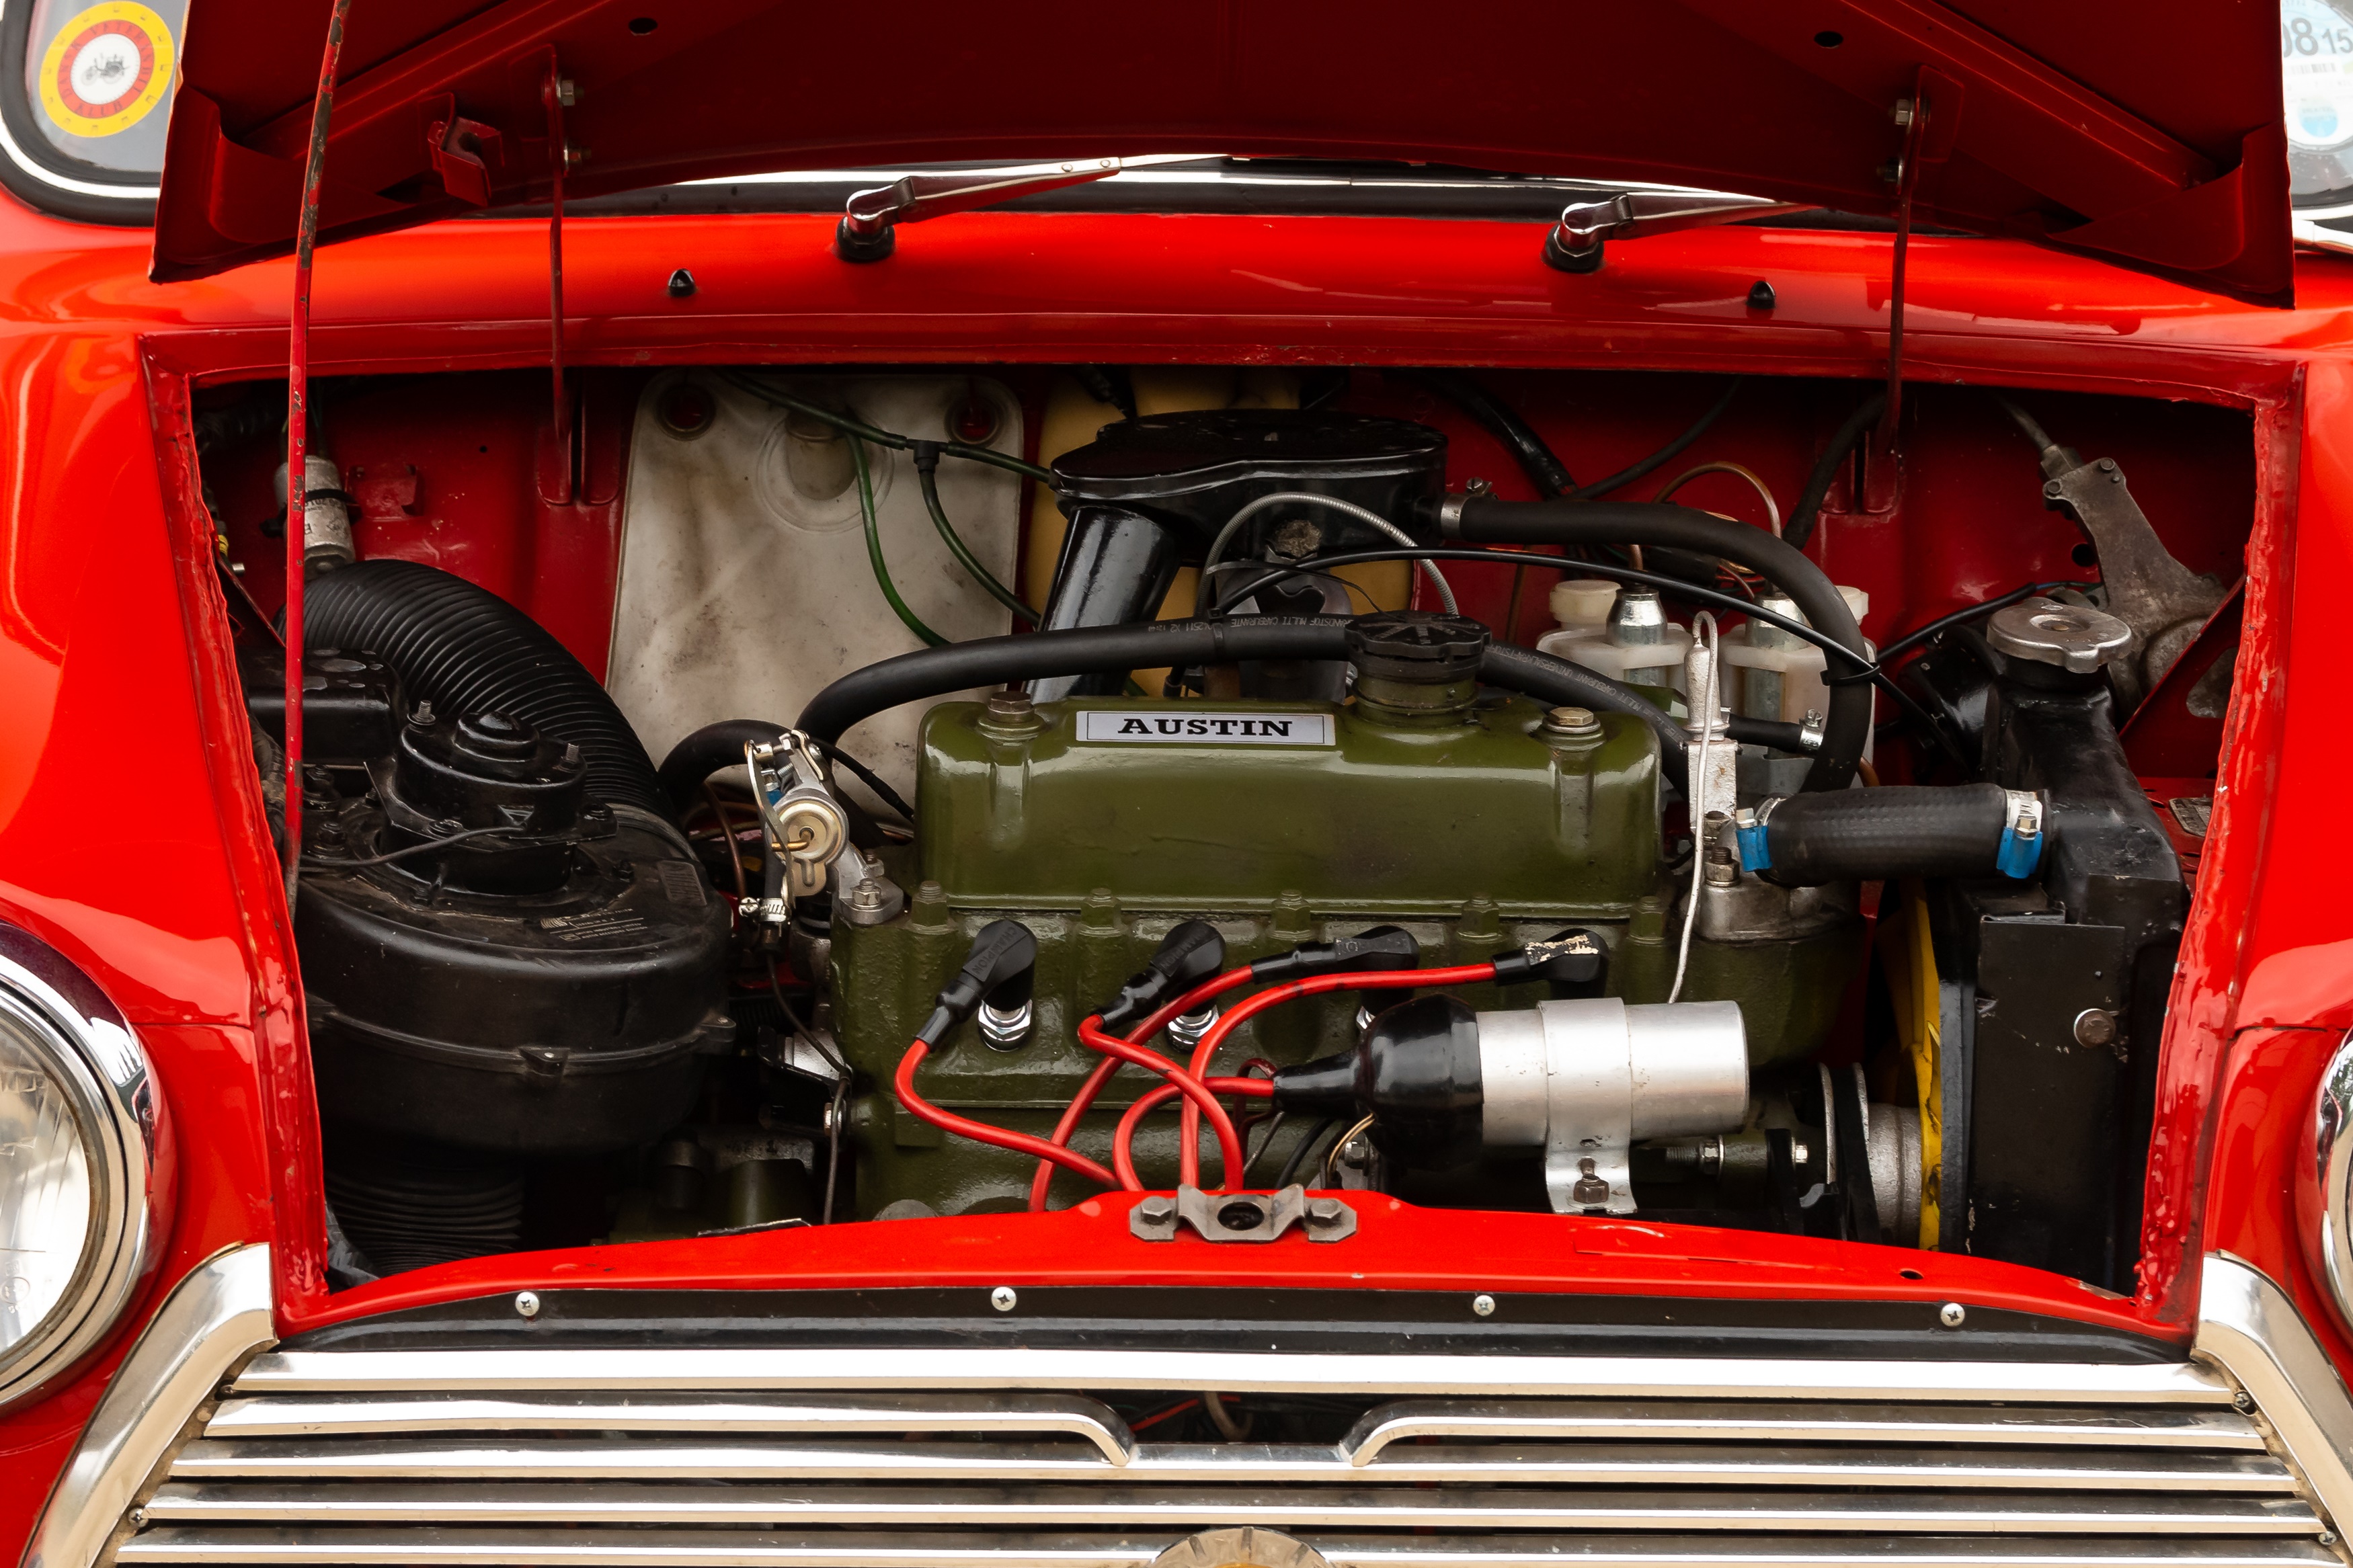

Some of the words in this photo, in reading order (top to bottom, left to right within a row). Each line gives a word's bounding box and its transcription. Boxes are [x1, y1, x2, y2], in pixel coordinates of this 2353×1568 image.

[2321, 29, 2353, 54] 15
[1117, 718, 1293, 737] AUSTIN
[971, 926, 1017, 975] CHAMPION
